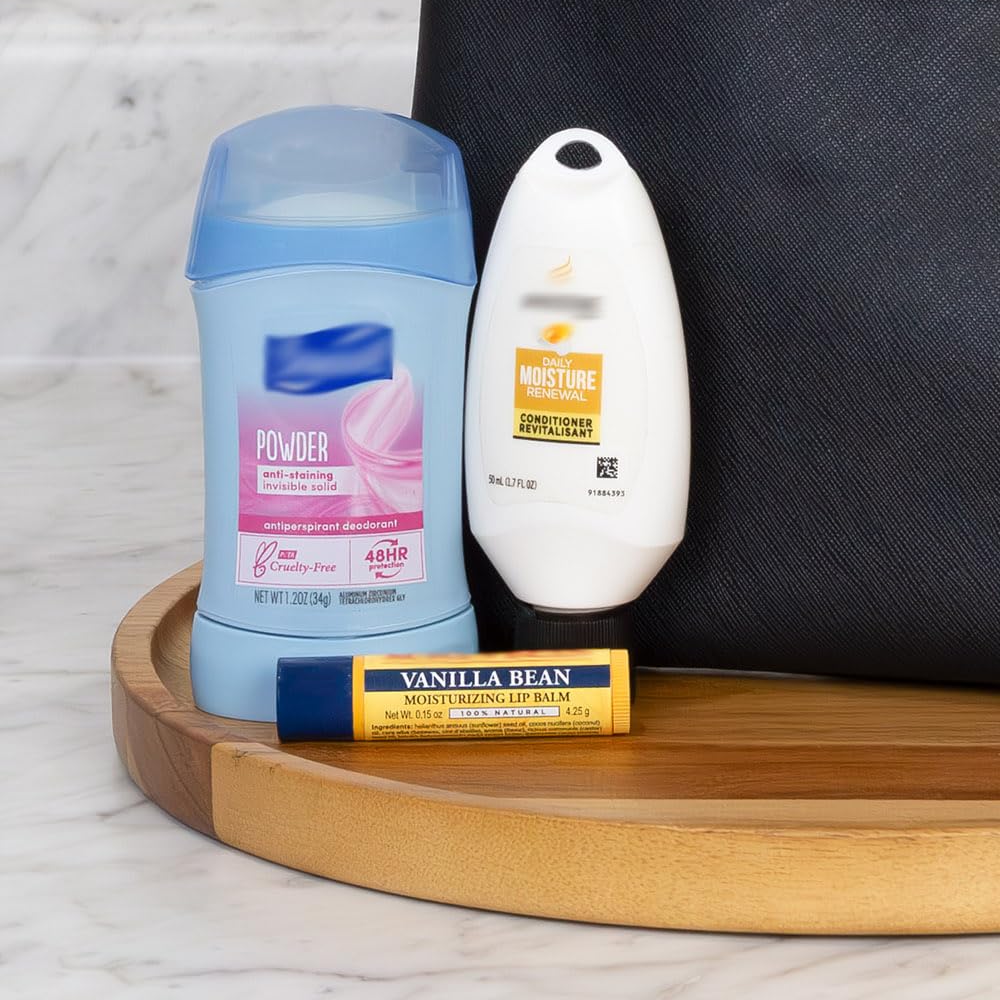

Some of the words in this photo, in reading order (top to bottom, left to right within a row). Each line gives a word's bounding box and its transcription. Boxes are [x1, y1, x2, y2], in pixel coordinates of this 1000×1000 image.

[542, 357, 572, 368] DAILY
[520, 365, 597, 390] MOISTURE
[527, 387, 588, 402] RENEWAL
[520, 413, 593, 428] CONDITIONER
[519, 423, 593, 438] REVITALISANT
[257, 429, 328, 462] POWDER
[263, 470, 333, 481] anti-staining
[488, 474, 495, 484] 50
[505, 477, 516, 487] (1.7
[517, 479, 525, 488] FL
[263, 481, 307, 492] invisible
[311, 482, 337, 492] solid
[588, 489, 625, 497] 91884393
[264, 521, 339, 533] antiperspirant
[342, 519, 398, 531] deodorant
[365, 546, 408, 563] 48HR
[270, 561, 337, 574] Cruelty-Free
[369, 561, 404, 571] protection
[254, 590, 268, 603] NET
[270, 592, 283, 604] WT
[310, 592, 331, 607] (34g)
[400, 670, 502, 689] VANILLA
[509, 669, 571, 686] BEAN
[404, 693, 505, 705] MOISTURIZING
[509, 693, 529, 703] LIP
[534, 692, 570, 702] BALM
[385, 711, 399, 719] Net
[415, 710, 431, 719] 0.15
[565, 706, 582, 716] 4.25
[584, 708, 590, 717] g
